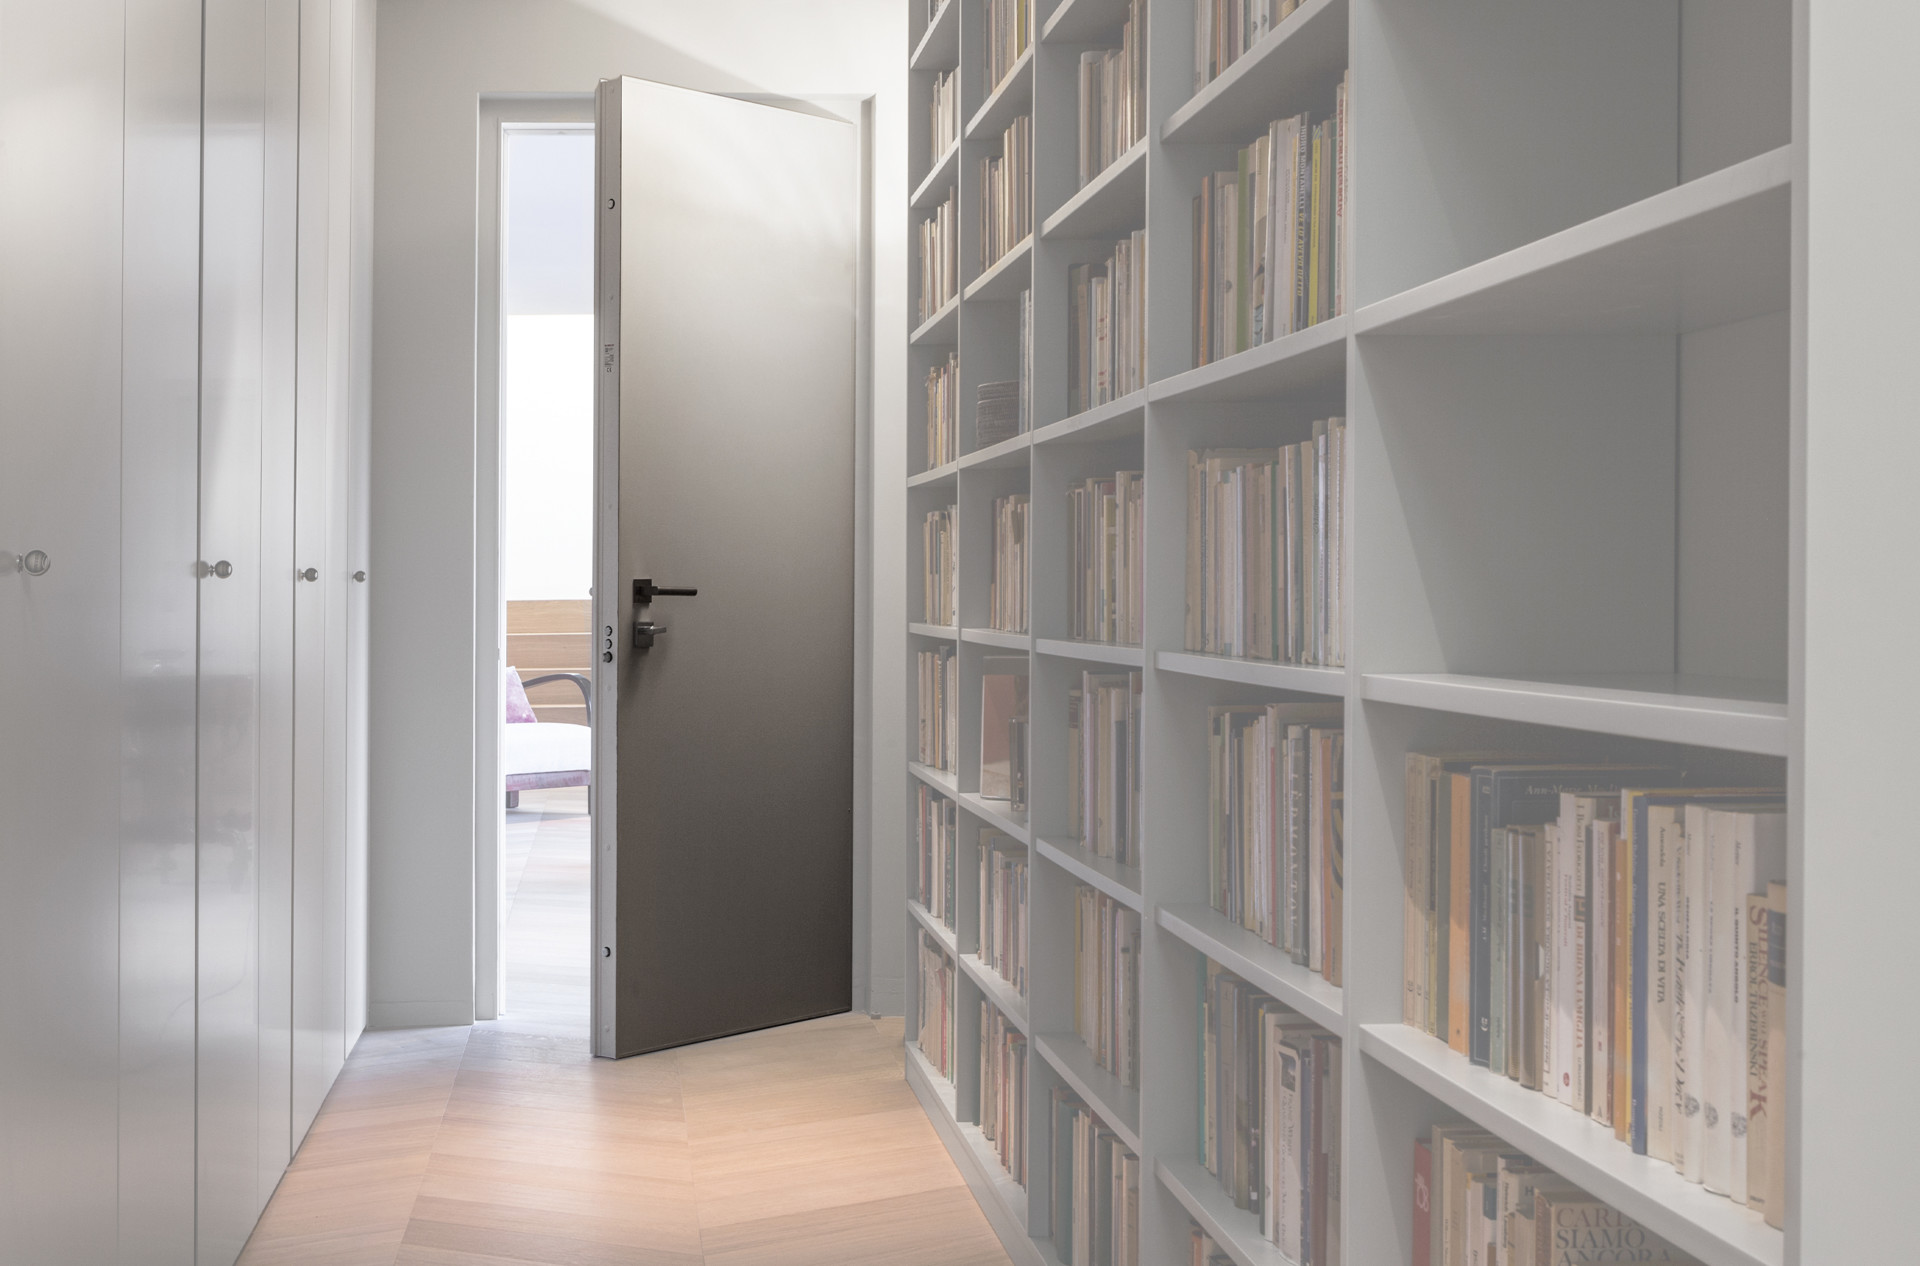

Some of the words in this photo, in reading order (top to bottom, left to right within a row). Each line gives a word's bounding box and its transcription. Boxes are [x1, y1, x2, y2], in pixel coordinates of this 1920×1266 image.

[1336, 97, 1344, 138] padre
[1299, 126, 1307, 153] INDRO
[1298, 155, 1307, 209] MONTANELLI
[1297, 225, 1305, 237] LO
[1298, 212, 1305, 223] VE
[1297, 238, 1305, 267] AVEVO
[1296, 269, 1304, 297] DETTO
[1658, 826, 1667, 868] Amendola
[1656, 881, 1667, 908] UNA
[1576, 925, 1584, 940] DI
[1656, 910, 1667, 957] SCELTA
[1575, 942, 1584, 987] BUONA
[1656, 959, 1667, 973] DI
[1748, 905, 1769, 1008] SILENCE
[1748, 941, 1758, 985] ERROL
[1656, 975, 1667, 1004] VITA
[1575, 988, 1584, 1049] FAMIGLIA
[1749, 1038, 1768, 1121] SPEAK
[1556, 1207, 1640, 1228] CARL
[1555, 1228, 1646, 1250] SIAMO
